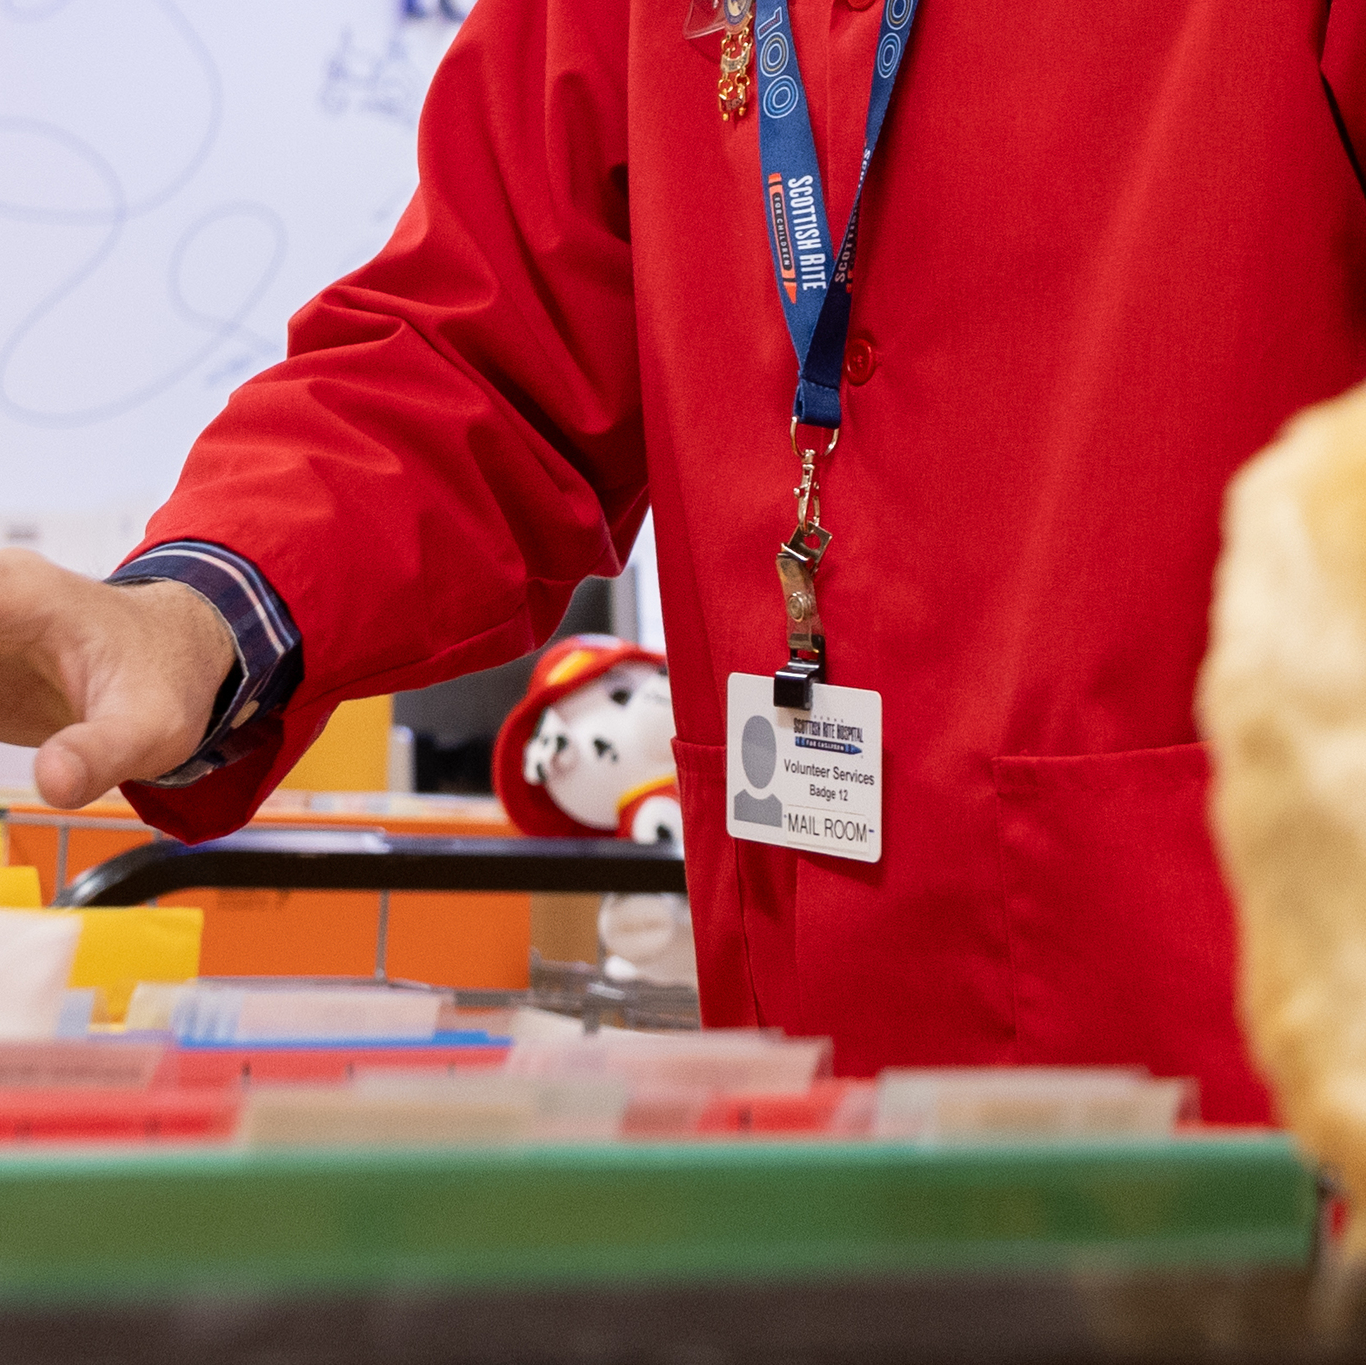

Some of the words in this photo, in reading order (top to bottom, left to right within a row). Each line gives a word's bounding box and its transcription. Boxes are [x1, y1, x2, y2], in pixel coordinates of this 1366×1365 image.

[757, 6, 800, 119] 100
[774, 196, 782, 215] FOR
[788, 175, 822, 251] SCOTTISH
[776, 218, 791, 266] CHILDREN
[834, 203, 860, 283] SCOTTI
[799, 253, 827, 291] RITE
[822, 722, 836, 739] RITE
[837, 723, 864, 743] HOSPITAL
[784, 759, 830, 779] Volunteer
[833, 766, 875, 786] Services
[809, 784, 836, 802] Badge
[839, 789, 849, 802] 12
[788, 813, 820, 837] MAIL
[824, 818, 868, 843] ROOM
